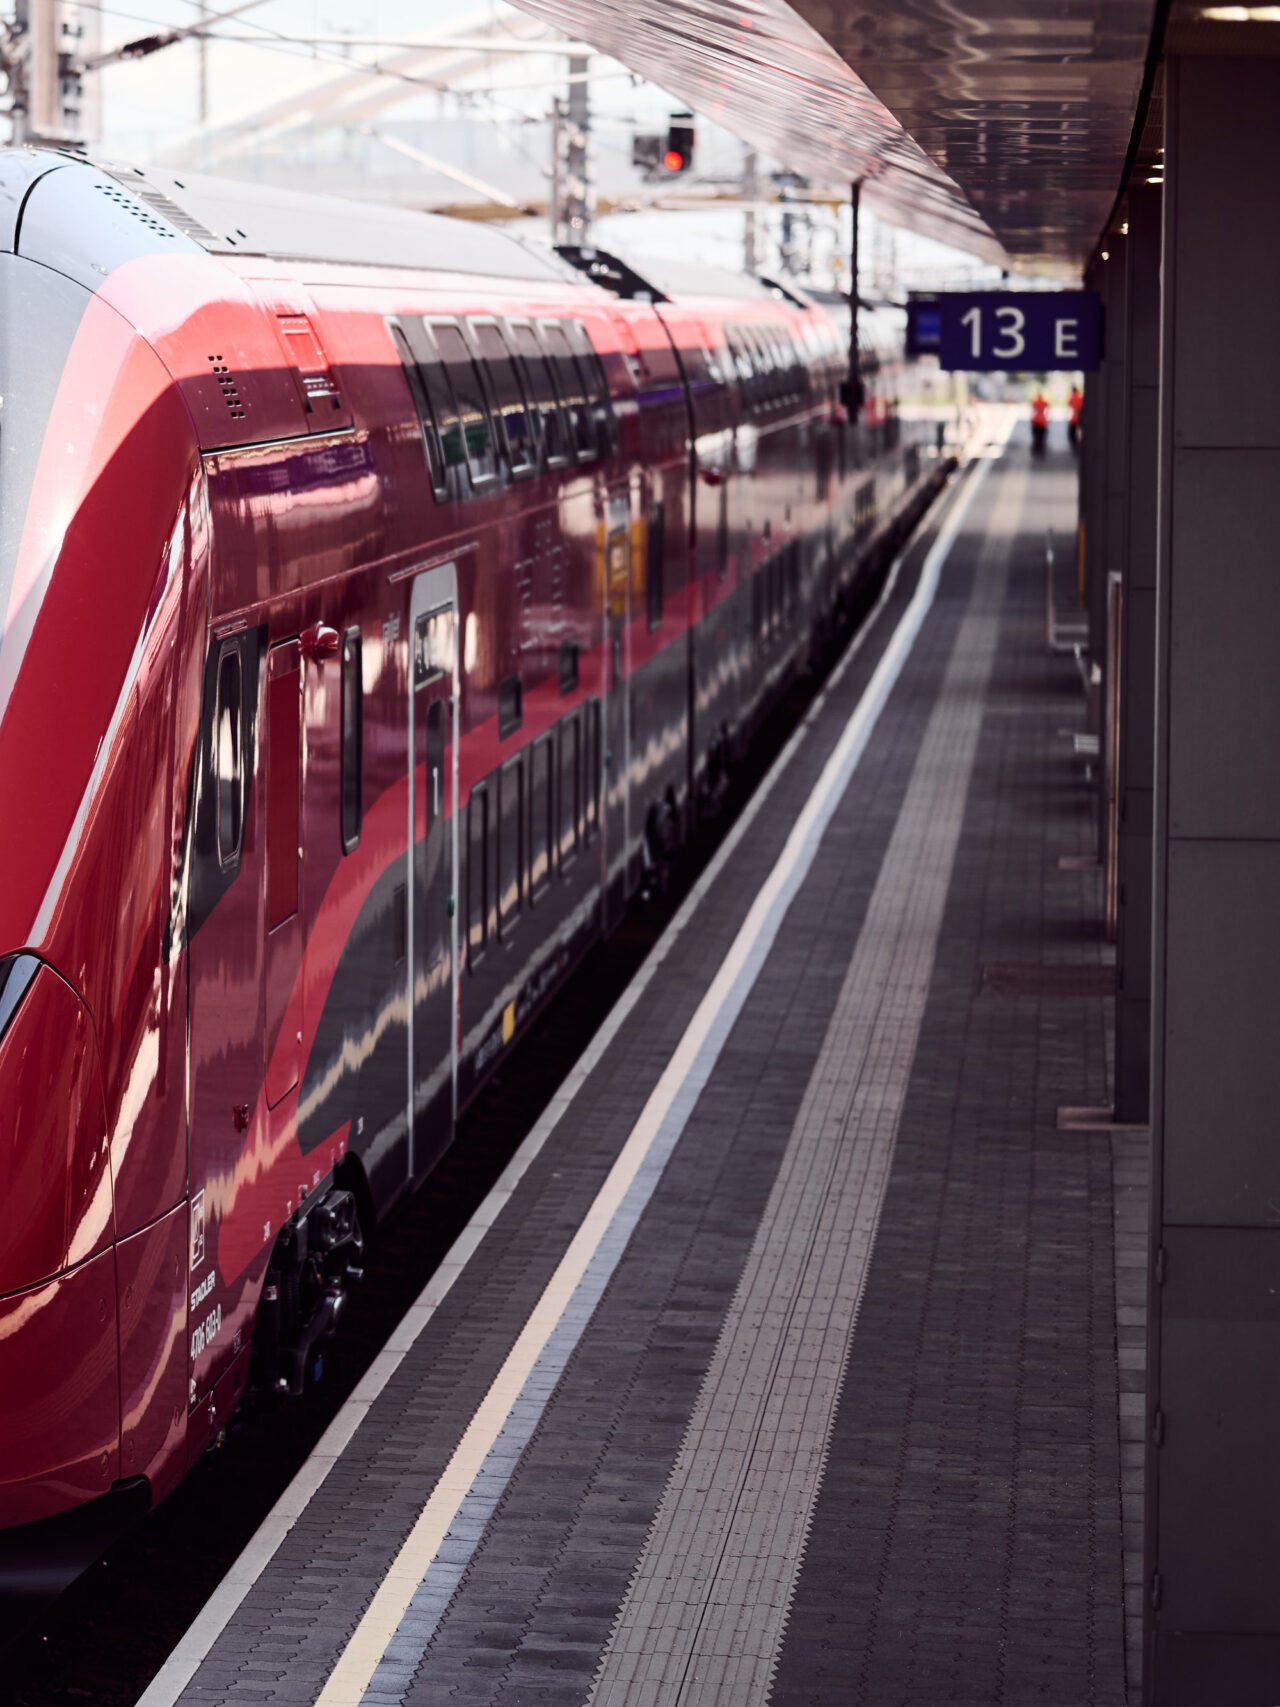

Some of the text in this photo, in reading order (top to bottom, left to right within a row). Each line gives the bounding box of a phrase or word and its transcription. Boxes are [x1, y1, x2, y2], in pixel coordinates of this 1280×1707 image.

[961, 306, 1078, 358] 13 E
[190, 1270, 216, 1312] STADLER
